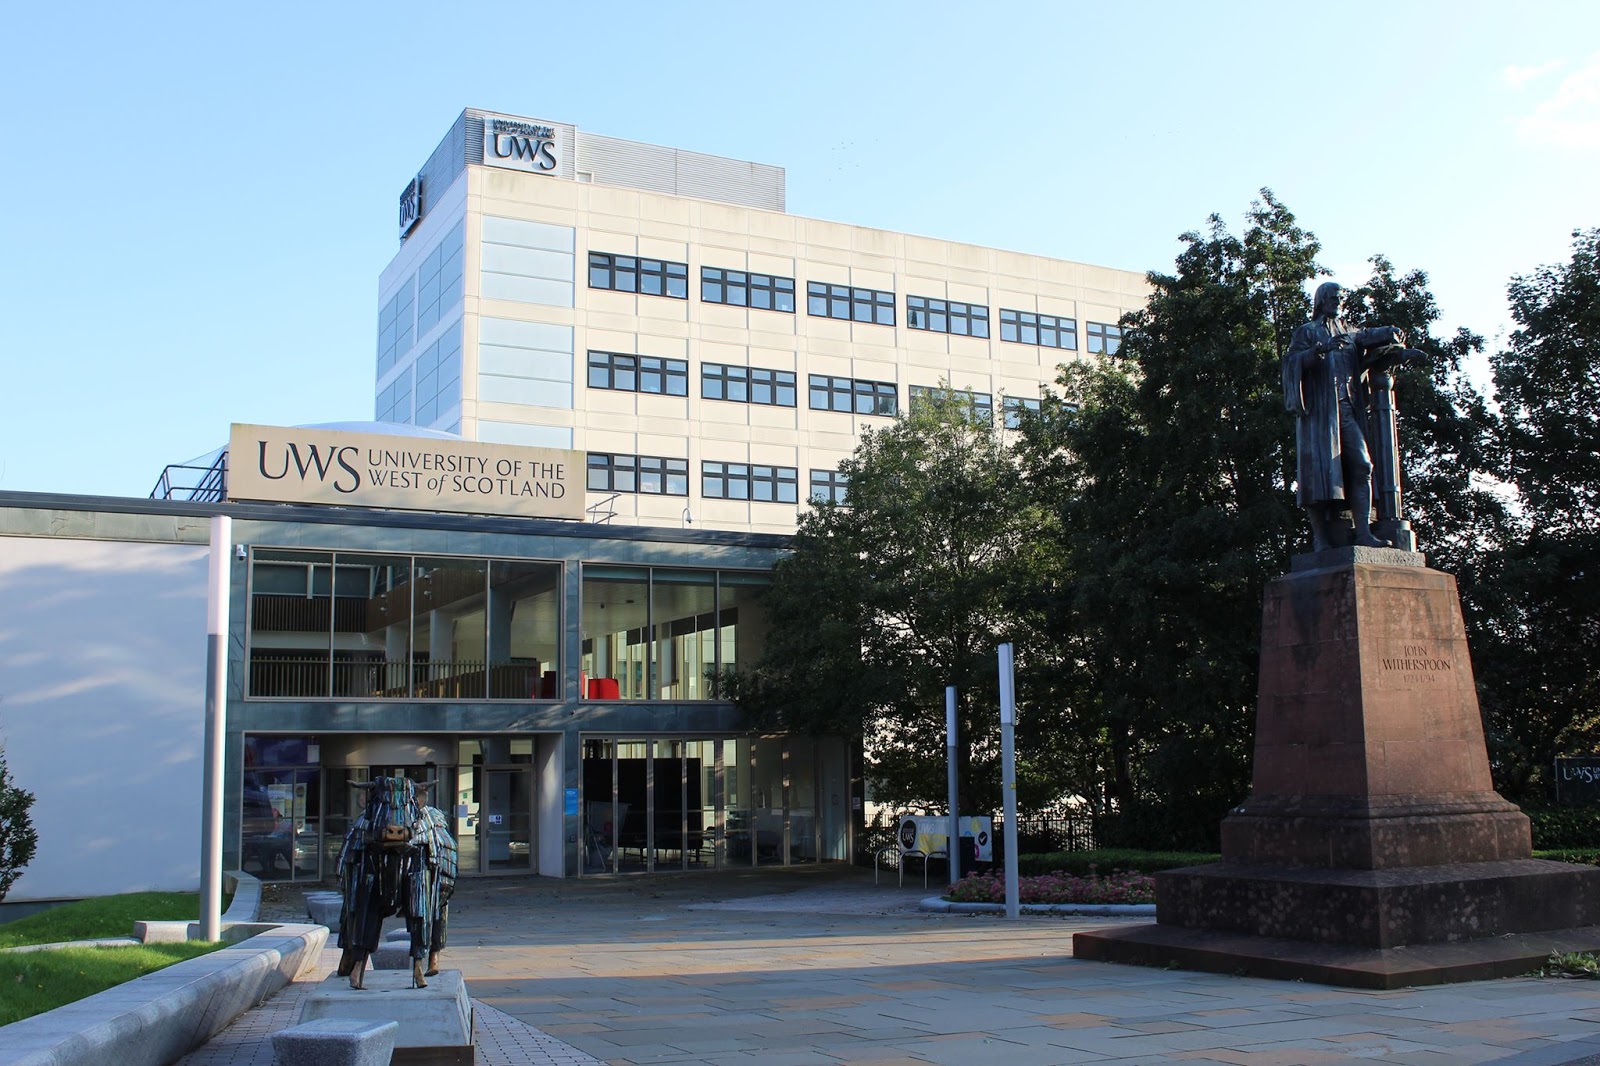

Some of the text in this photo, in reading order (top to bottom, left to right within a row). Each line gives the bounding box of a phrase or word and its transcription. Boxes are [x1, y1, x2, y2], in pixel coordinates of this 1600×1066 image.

[493, 118, 531, 129] UNIVERSITY
[493, 132, 556, 170] UWS
[258, 440, 361, 493] UWS
[368, 449, 565, 480] UNIVERSITY OF THE
[368, 469, 565, 499] WEST of SCOTLAND
[1403, 645, 1427, 657] JOHN
[1382, 659, 1451, 671] WITHERSPOON
[902, 832, 914, 843] UWS
